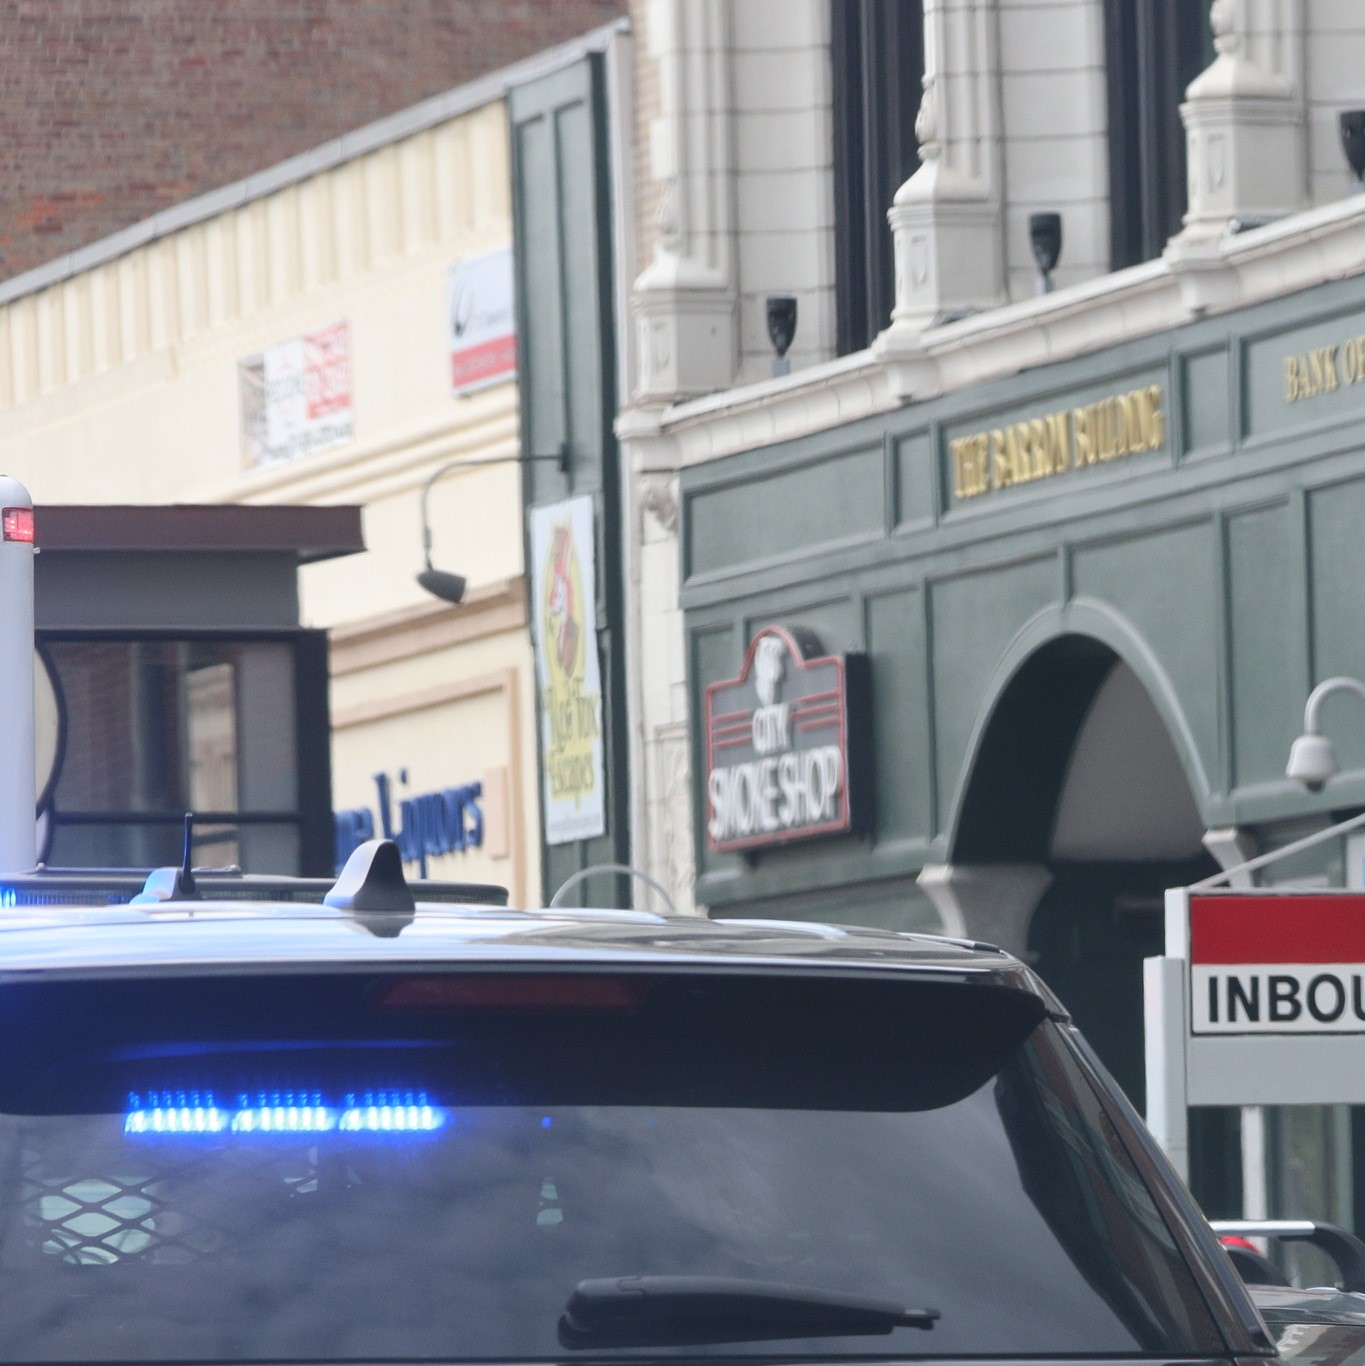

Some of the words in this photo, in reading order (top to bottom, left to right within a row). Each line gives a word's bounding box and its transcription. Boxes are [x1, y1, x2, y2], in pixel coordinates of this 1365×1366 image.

[1284, 346, 1338, 403] BANK
[951, 433, 991, 498] THE
[1073, 384, 1166, 468] BUILDING
[752, 702, 792, 754] CITY
[708, 757, 779, 840] SMOKE
[778, 745, 843, 827] SHOP
